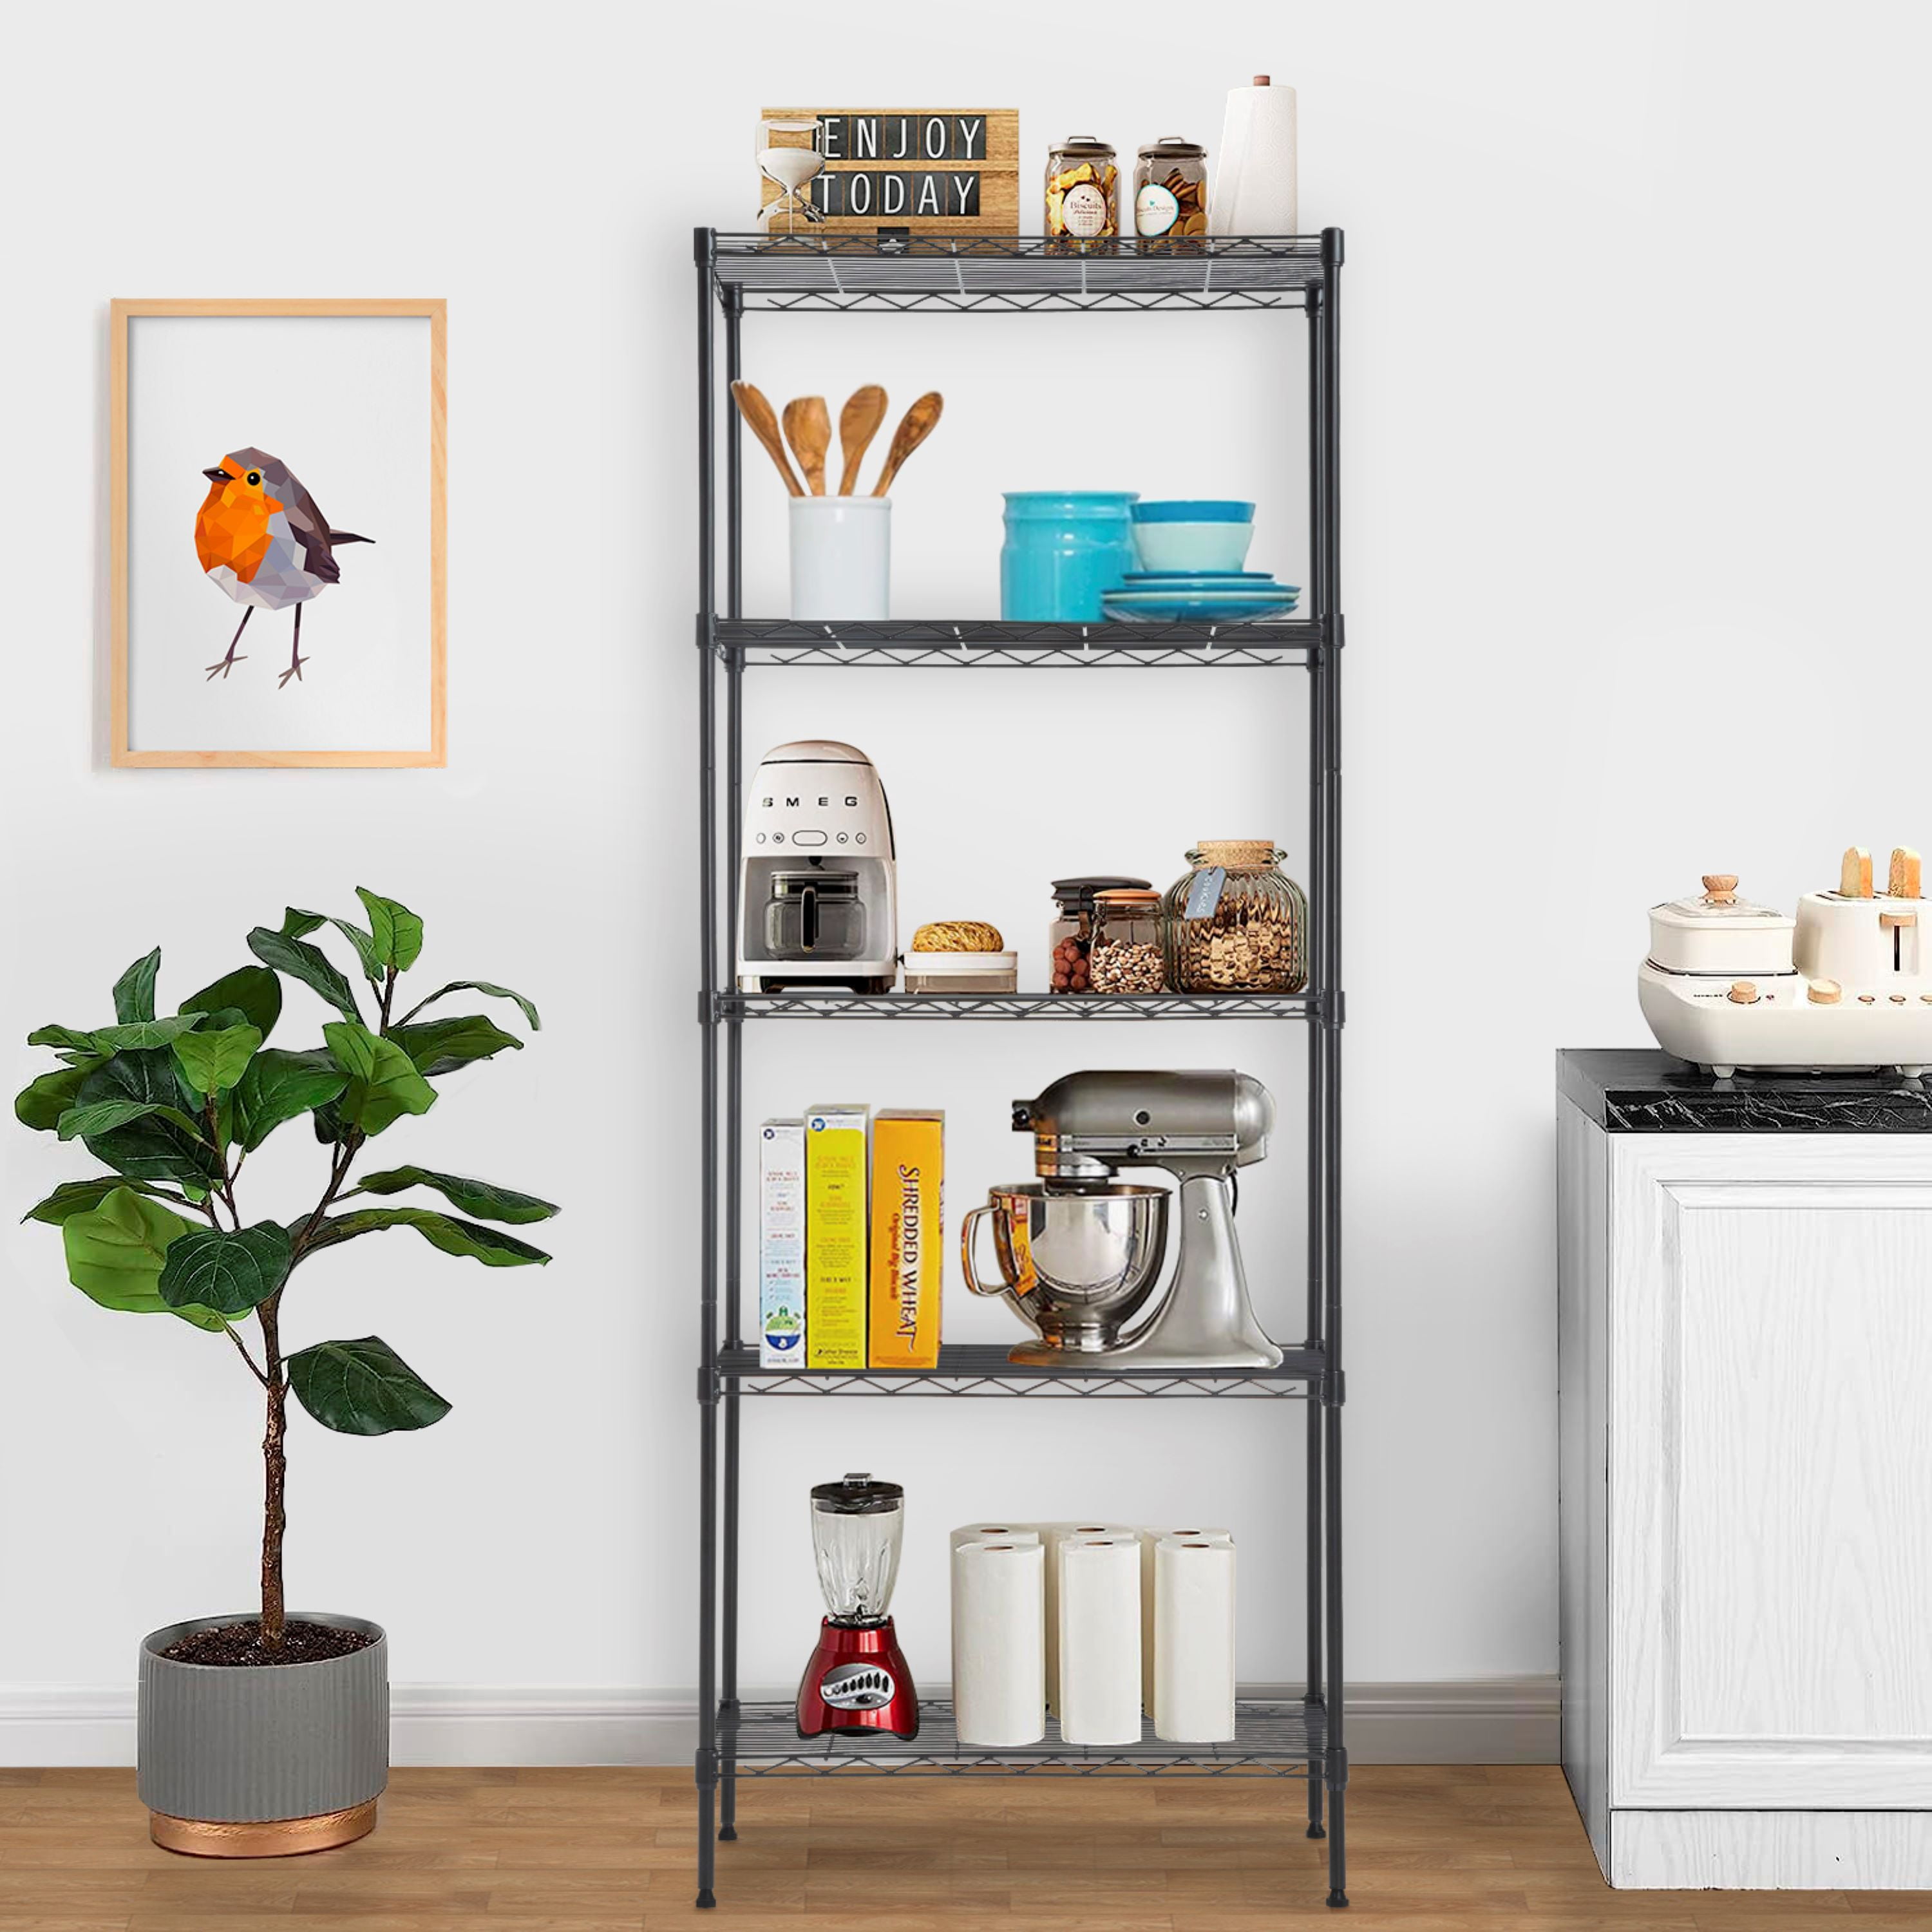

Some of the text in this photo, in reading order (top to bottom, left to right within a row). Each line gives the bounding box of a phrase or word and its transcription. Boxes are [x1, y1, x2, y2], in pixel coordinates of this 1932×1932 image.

[824, 117, 981, 159] ENJOY
[817, 173, 975, 215] TODAY
[1070, 201, 1102, 209] Biscuits
[762, 796, 858, 808] SMEG
[888, 1213, 901, 1251] Original
[887, 1252, 900, 1268] Big
[896, 1164, 920, 1351] SHREDDED WHEAT
